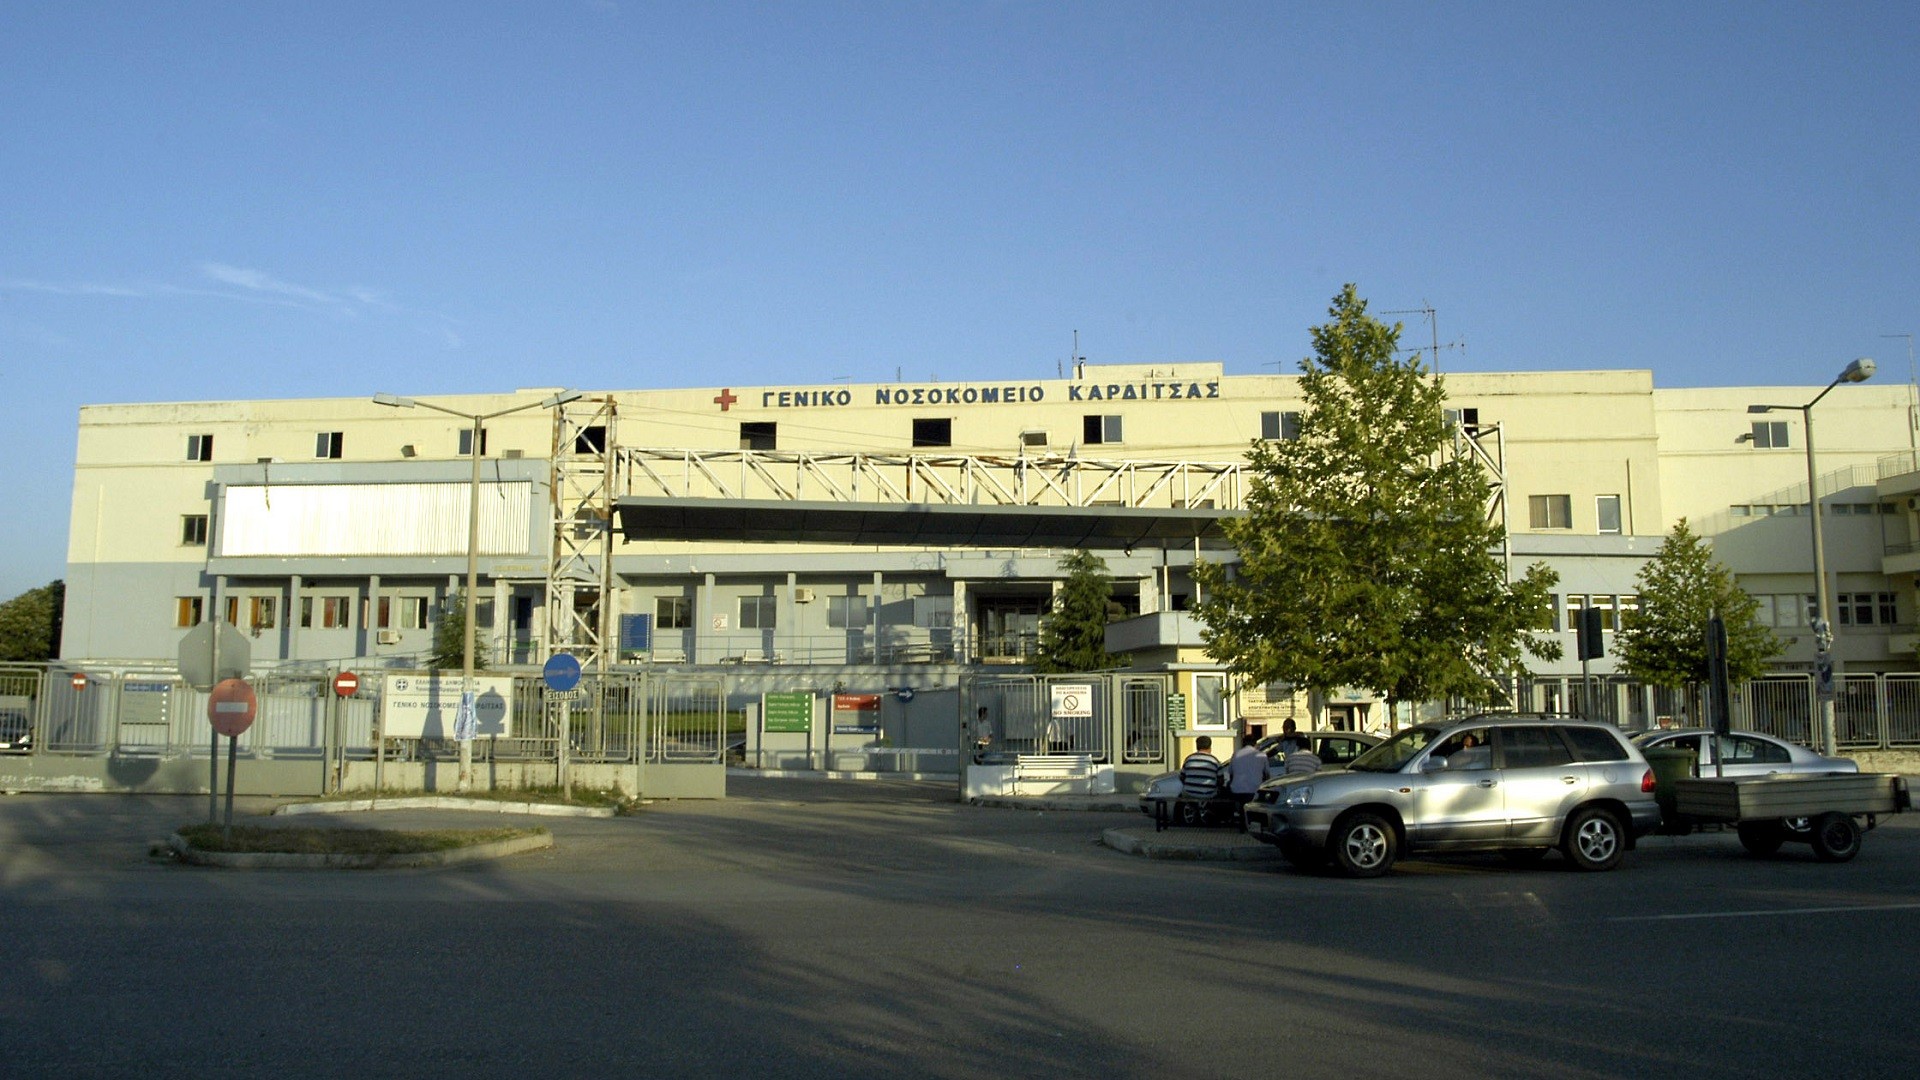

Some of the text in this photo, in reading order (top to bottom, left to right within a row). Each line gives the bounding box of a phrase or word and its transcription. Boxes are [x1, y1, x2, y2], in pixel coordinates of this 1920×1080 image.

[763, 382, 1220, 408] ΓΕΝΙΚΟ ΝΟΣΟΚΟΜΕΙΟ ΚΑΡΔΙΤΣΑΣ
[548, 690, 578, 700] ΕΙΣΟΔΟΣ
